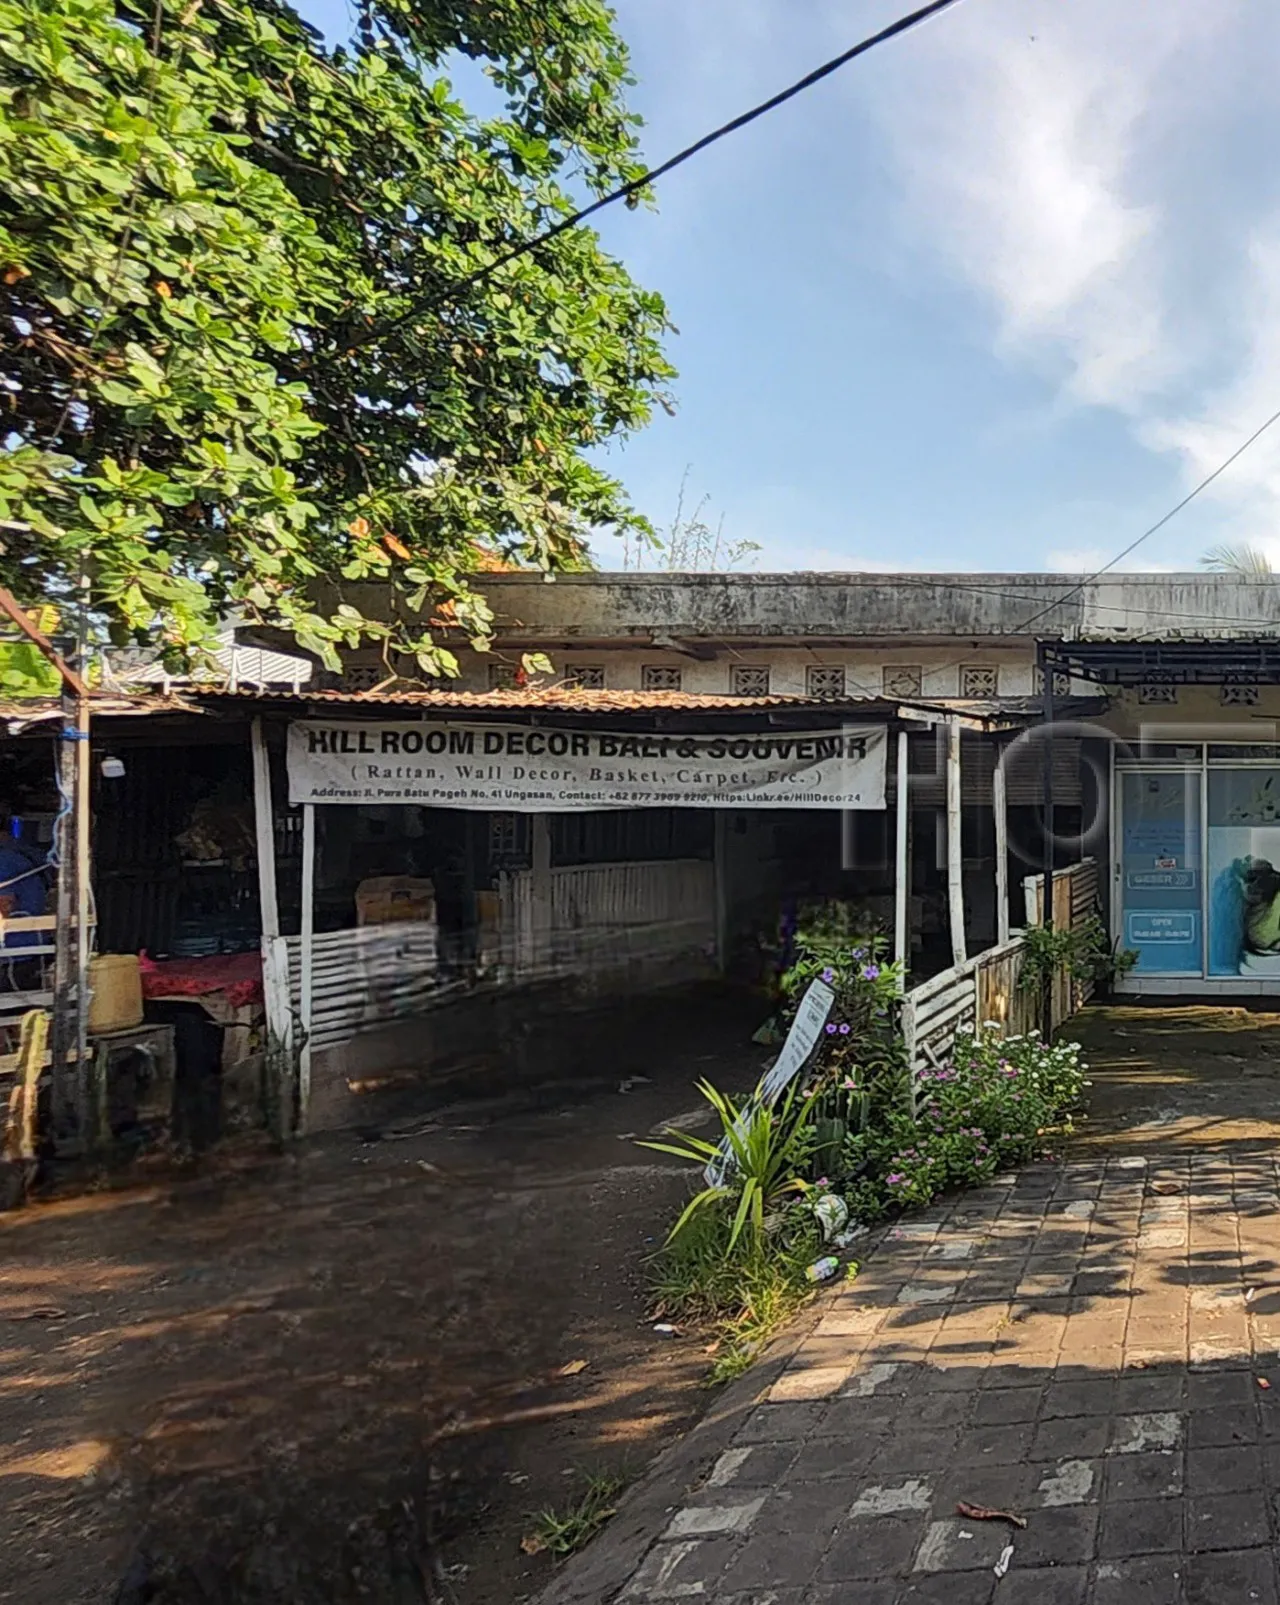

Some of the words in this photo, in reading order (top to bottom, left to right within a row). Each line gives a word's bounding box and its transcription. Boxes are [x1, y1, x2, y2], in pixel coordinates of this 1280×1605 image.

[308, 731, 375, 754] HILL
[381, 731, 474, 755] ROOM
[484, 732, 590, 757] DECOR
[598, 735, 671, 758] BALI
[676, 735, 699, 759] &
[706, 736, 867, 760] SOUVENIR
[368, 765, 445, 781] Rattan,
[455, 766, 502, 780] Wall
[512, 766, 577, 783] Decor,
[588, 768, 667, 785] Basket,
[676, 769, 757, 787] Carpet,
[311, 787, 362, 798] Address:
[377, 788, 402, 799] Pura
[404, 788, 430, 799] Batu
[432, 788, 467, 801] Pageh
[471, 789, 488, 799] No.
[504, 789, 556, 802] Ungasan,
[558, 790, 605, 801] Contact:
[608, 791, 628, 802] +62
